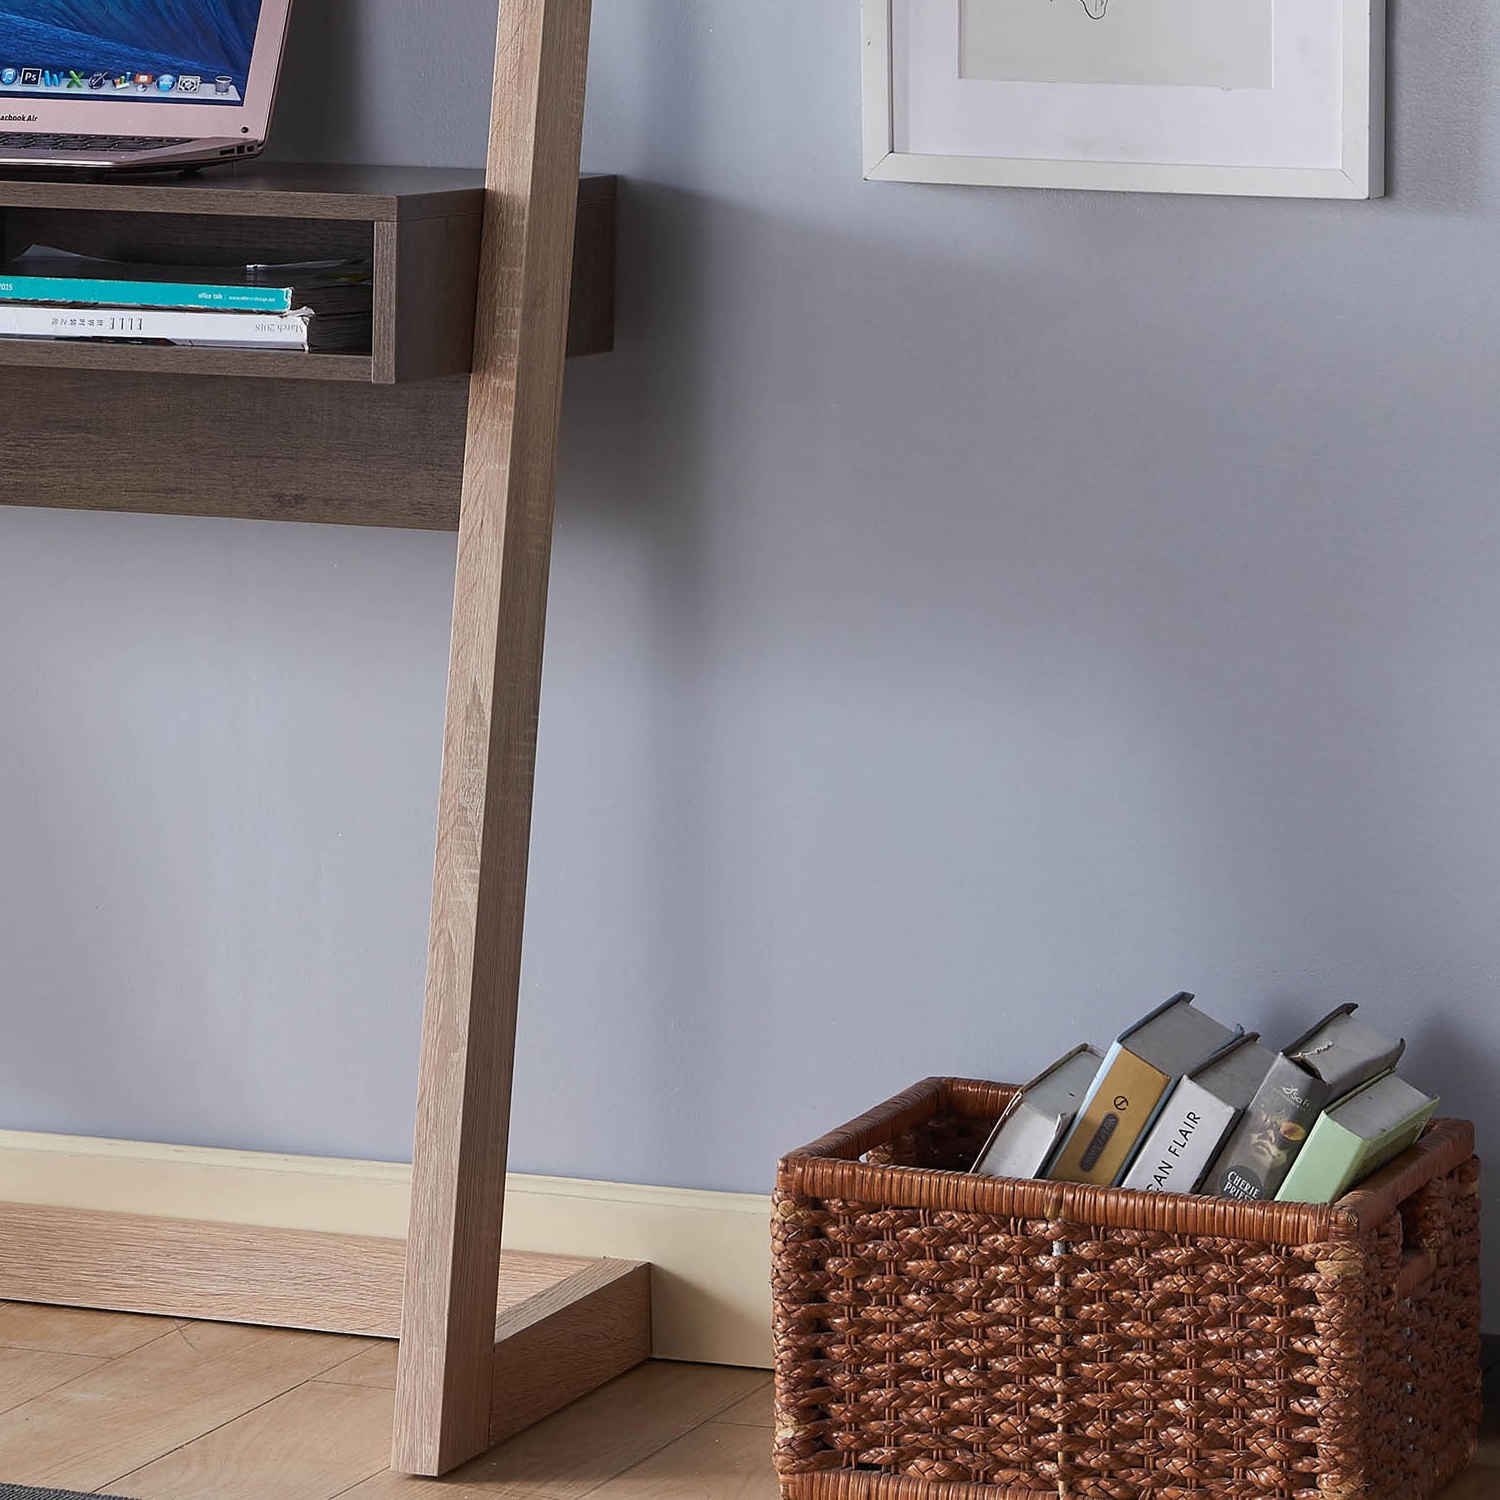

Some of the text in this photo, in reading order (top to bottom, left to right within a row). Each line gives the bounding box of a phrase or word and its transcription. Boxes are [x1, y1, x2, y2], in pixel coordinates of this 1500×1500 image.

[24, 72, 37, 82] Ps
[110, 317, 143, 330] ELLE
[254, 323, 304, 333] March 2018
[1167, 1111, 1201, 1158] FLAIR
[1223, 1181, 1255, 1201] PRIES
[1227, 1171, 1261, 1199] CHERIE
